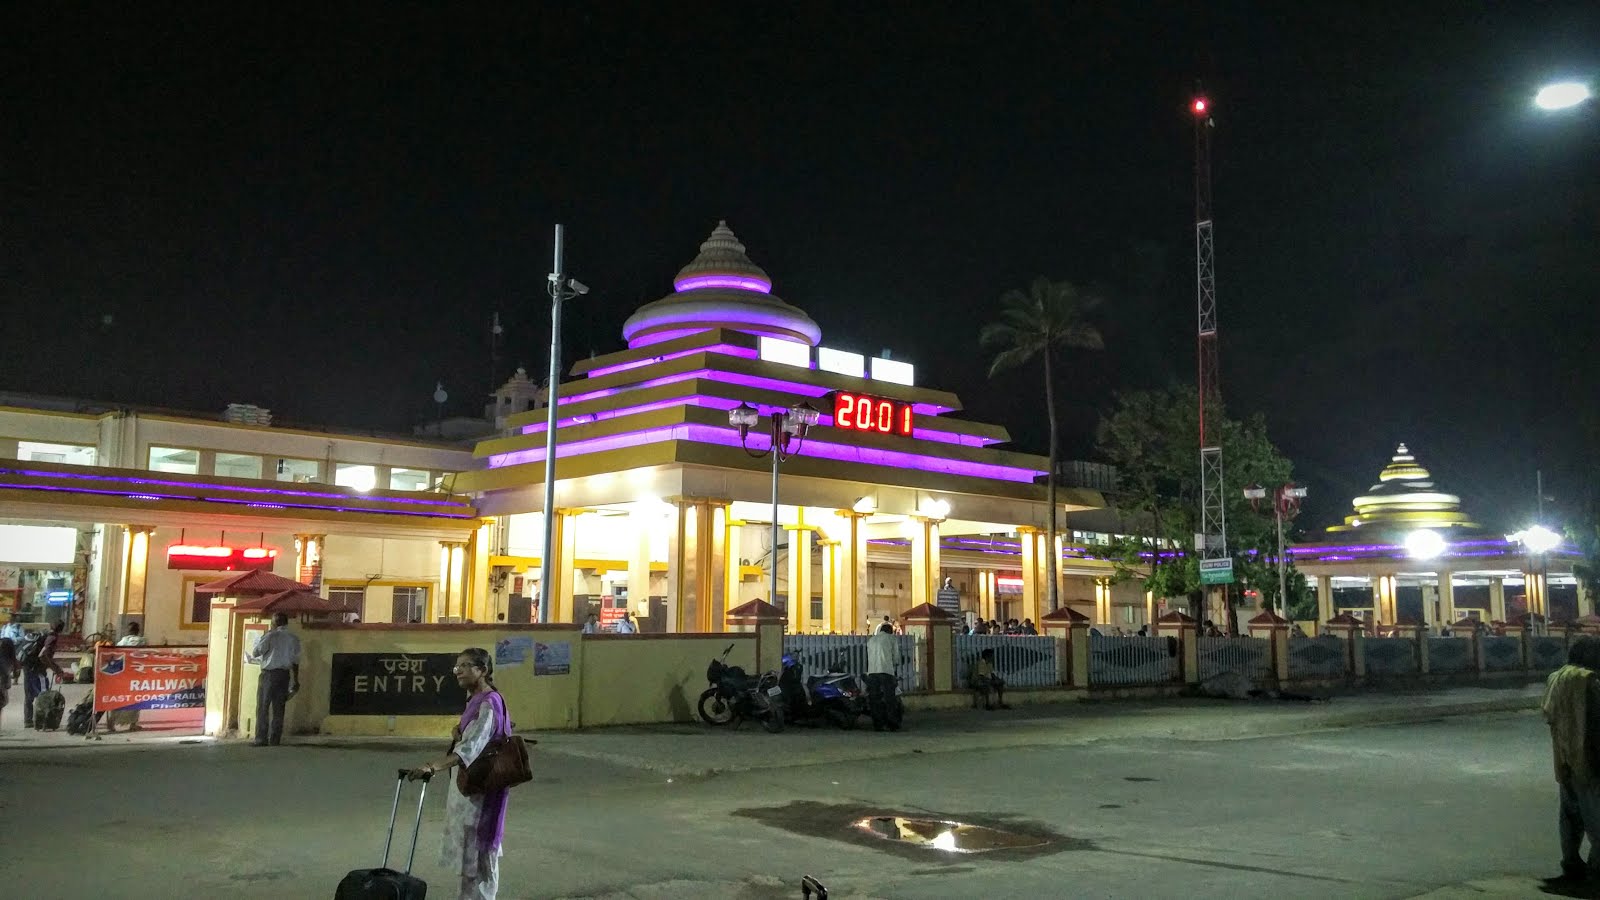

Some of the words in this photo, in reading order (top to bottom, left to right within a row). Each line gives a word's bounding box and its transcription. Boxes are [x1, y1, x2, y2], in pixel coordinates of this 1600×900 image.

[130, 661, 202, 674] रेलवे
[379, 655, 427, 674] प्रवेश
[129, 679, 197, 692] RAILWAY
[354, 675, 446, 693] ENTRY
[102, 694, 132, 703] EAST
[135, 693, 170, 702] COAST
